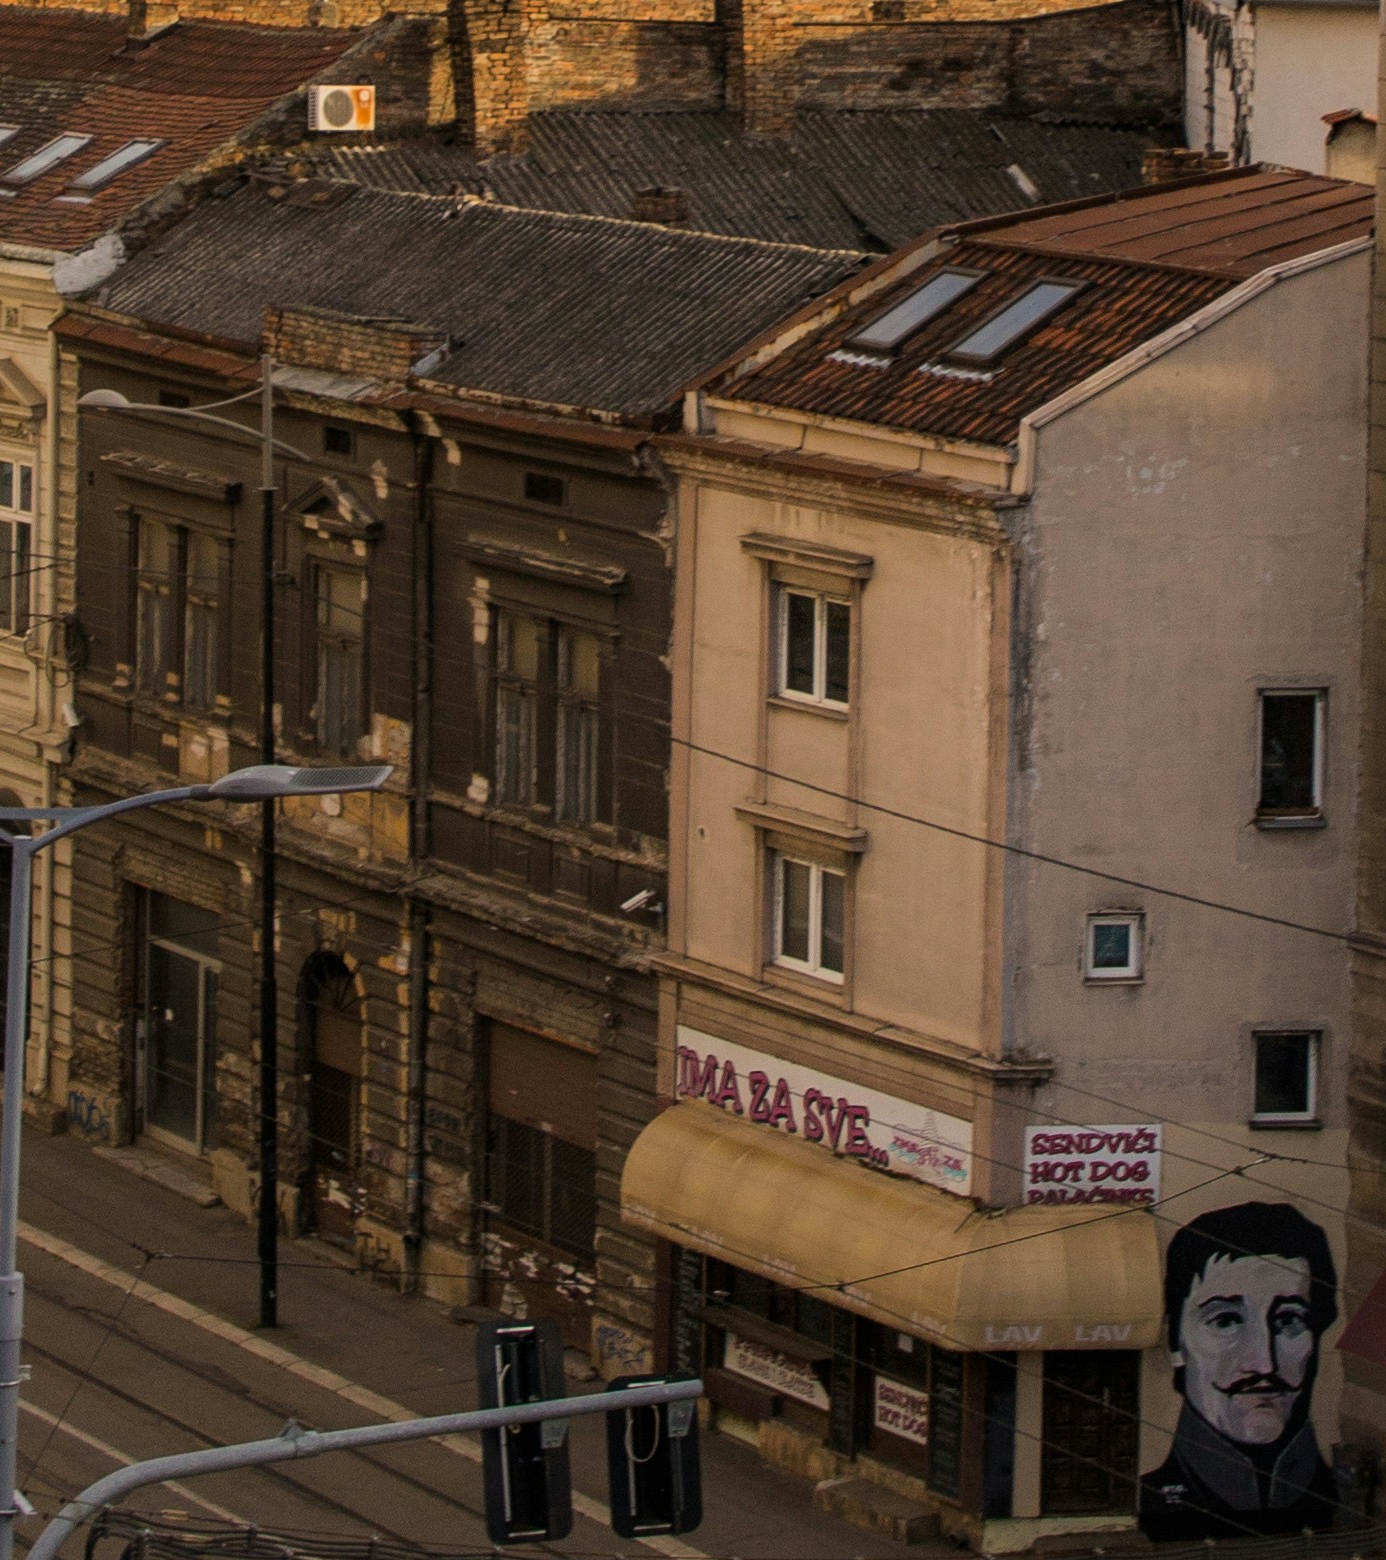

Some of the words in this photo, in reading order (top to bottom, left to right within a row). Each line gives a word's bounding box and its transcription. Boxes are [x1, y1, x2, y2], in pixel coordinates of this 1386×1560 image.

[677, 1045, 744, 1116] IMA
[748, 1070, 797, 1133] ZA
[1031, 1128, 1157, 1155] SENDVIČI
[1029, 1159, 1085, 1184] HOT
[1088, 1160, 1150, 1183] DOG
[983, 1325, 1044, 1344] LAV
[1074, 1324, 1133, 1343] LAV
